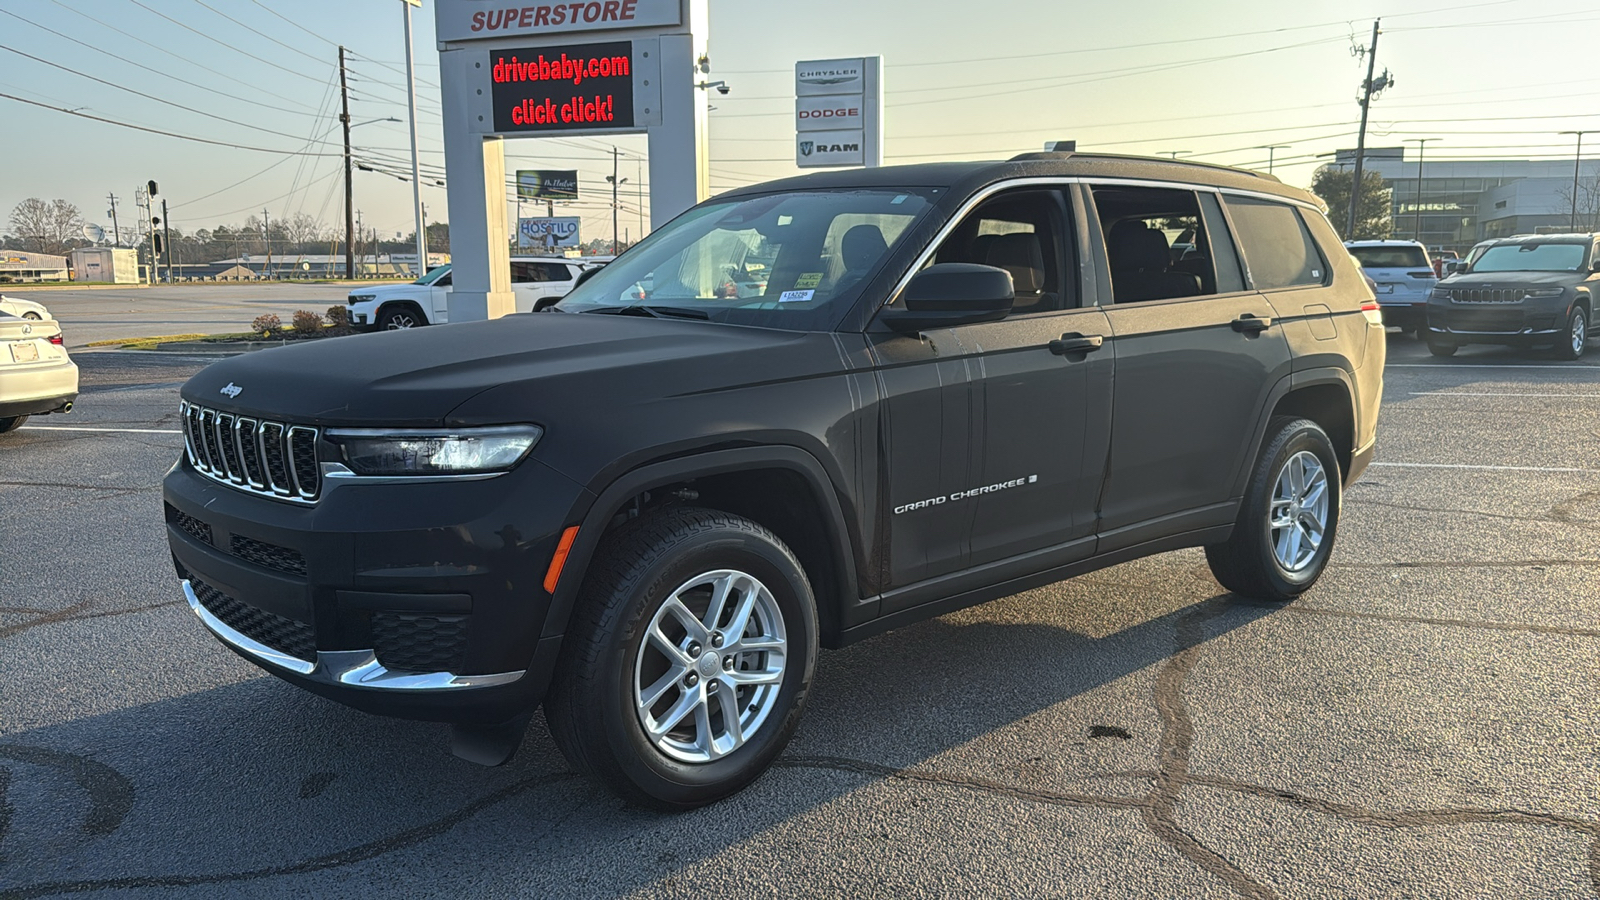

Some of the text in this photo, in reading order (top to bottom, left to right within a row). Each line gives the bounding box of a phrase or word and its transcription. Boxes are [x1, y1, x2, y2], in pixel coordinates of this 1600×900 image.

[471, 0, 638, 32] SUPERSTORE
[493, 53, 630, 85] drivebaby.com
[799, 69, 858, 78] CHRYSLER
[512, 95, 614, 126] click click!
[799, 108, 859, 119] DODGE
[816, 143, 859, 153] RAM
[521, 222, 577, 234] HOSTILO
[220, 382, 243, 399] Jeep
[894, 477, 1026, 515] GRAND CHEROKEE
